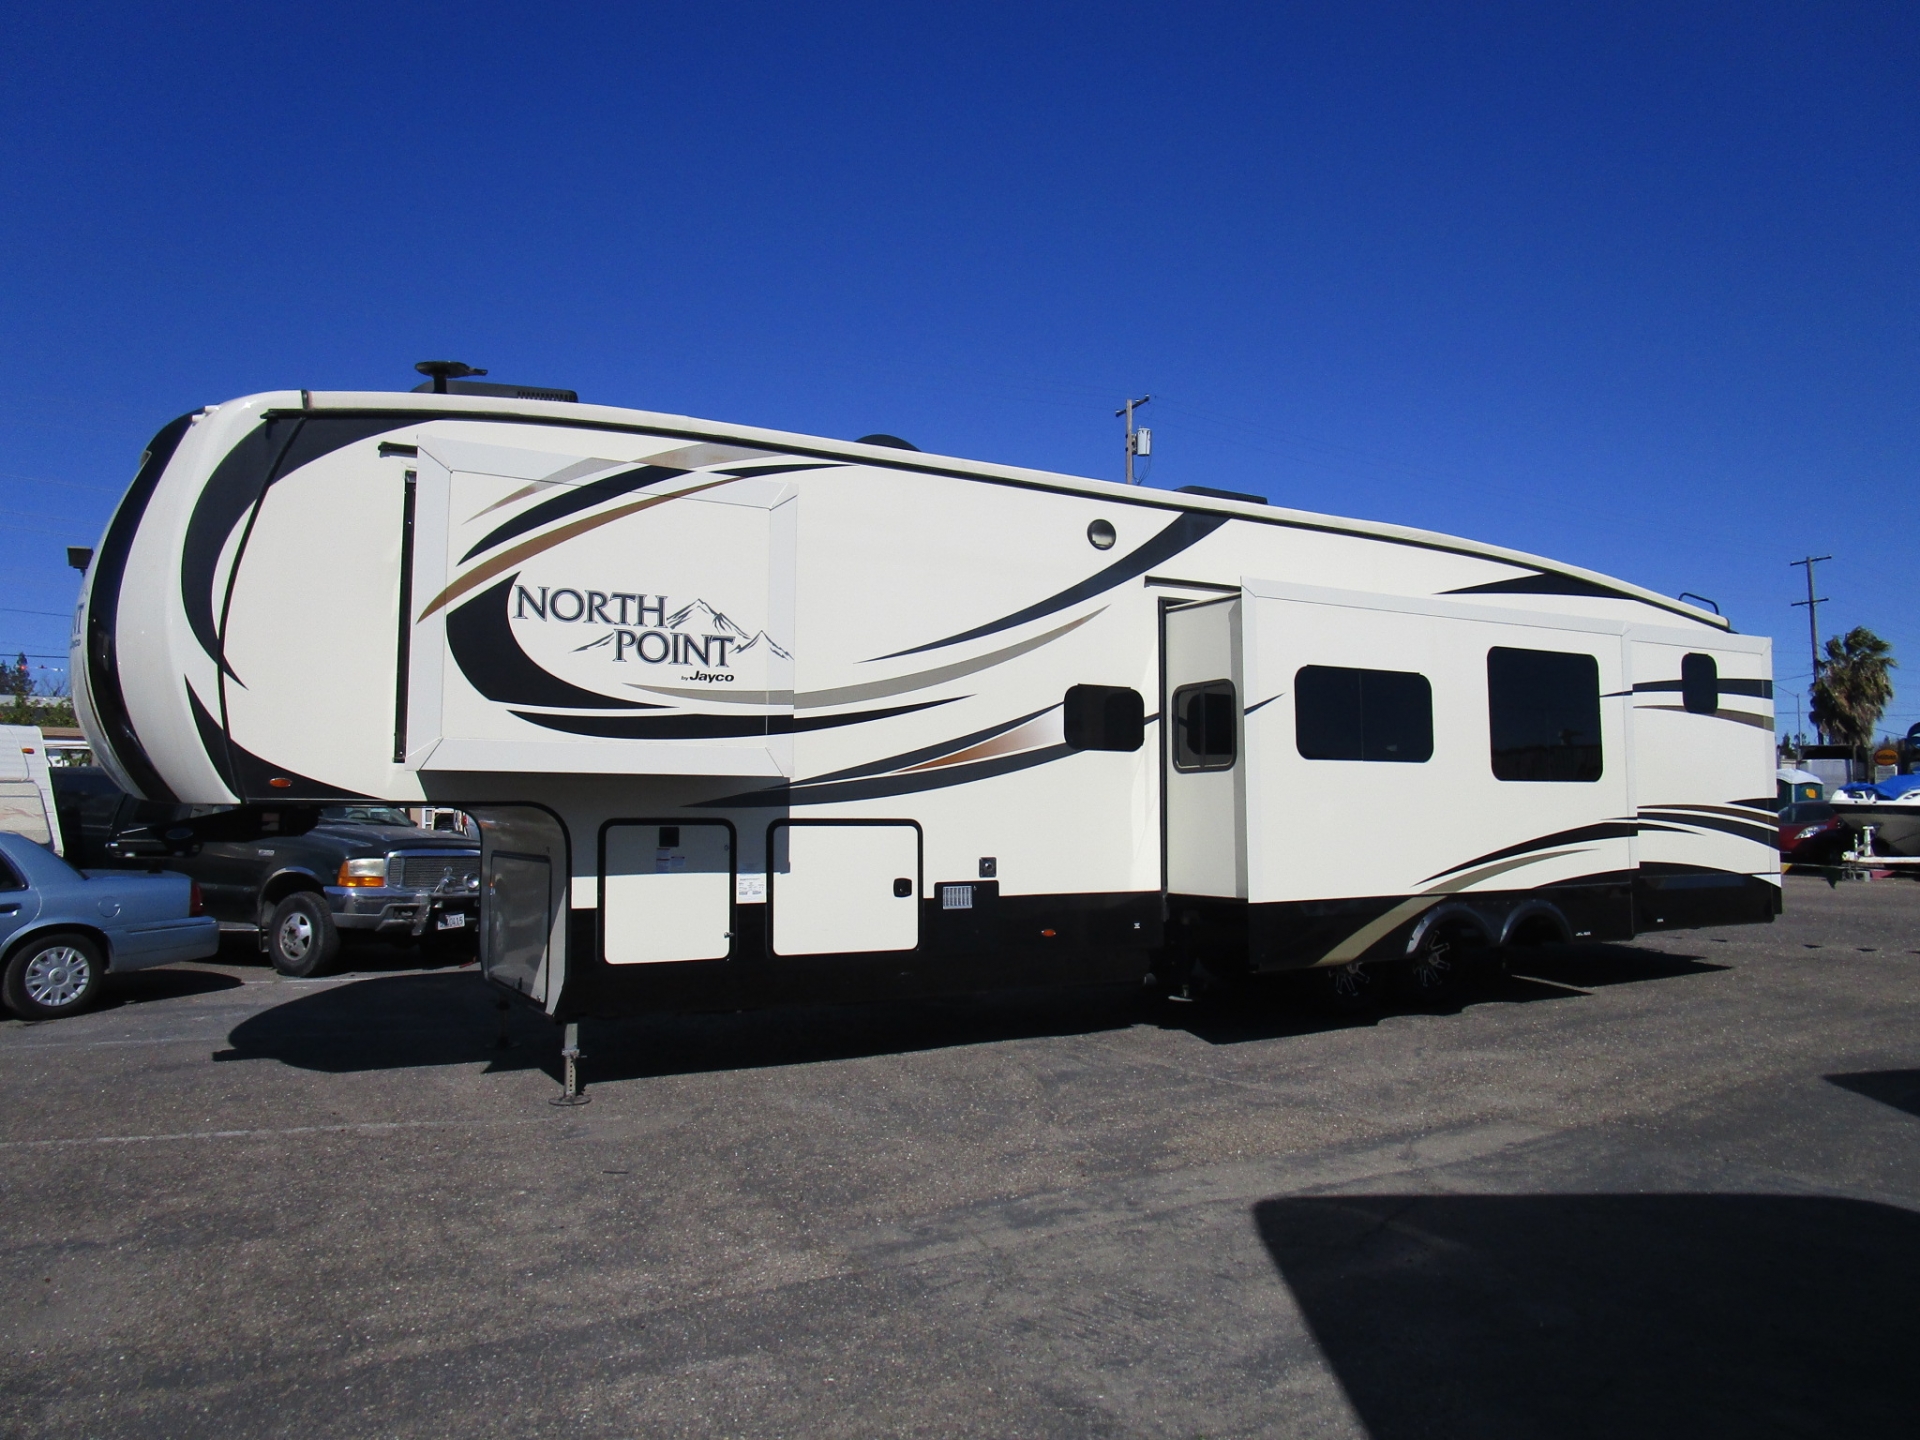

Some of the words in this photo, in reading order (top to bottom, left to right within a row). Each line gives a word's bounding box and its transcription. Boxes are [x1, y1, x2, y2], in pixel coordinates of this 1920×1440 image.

[513, 584, 668, 628] NORTH
[612, 628, 736, 668] POINT
[689, 670, 735, 684] Jayco
